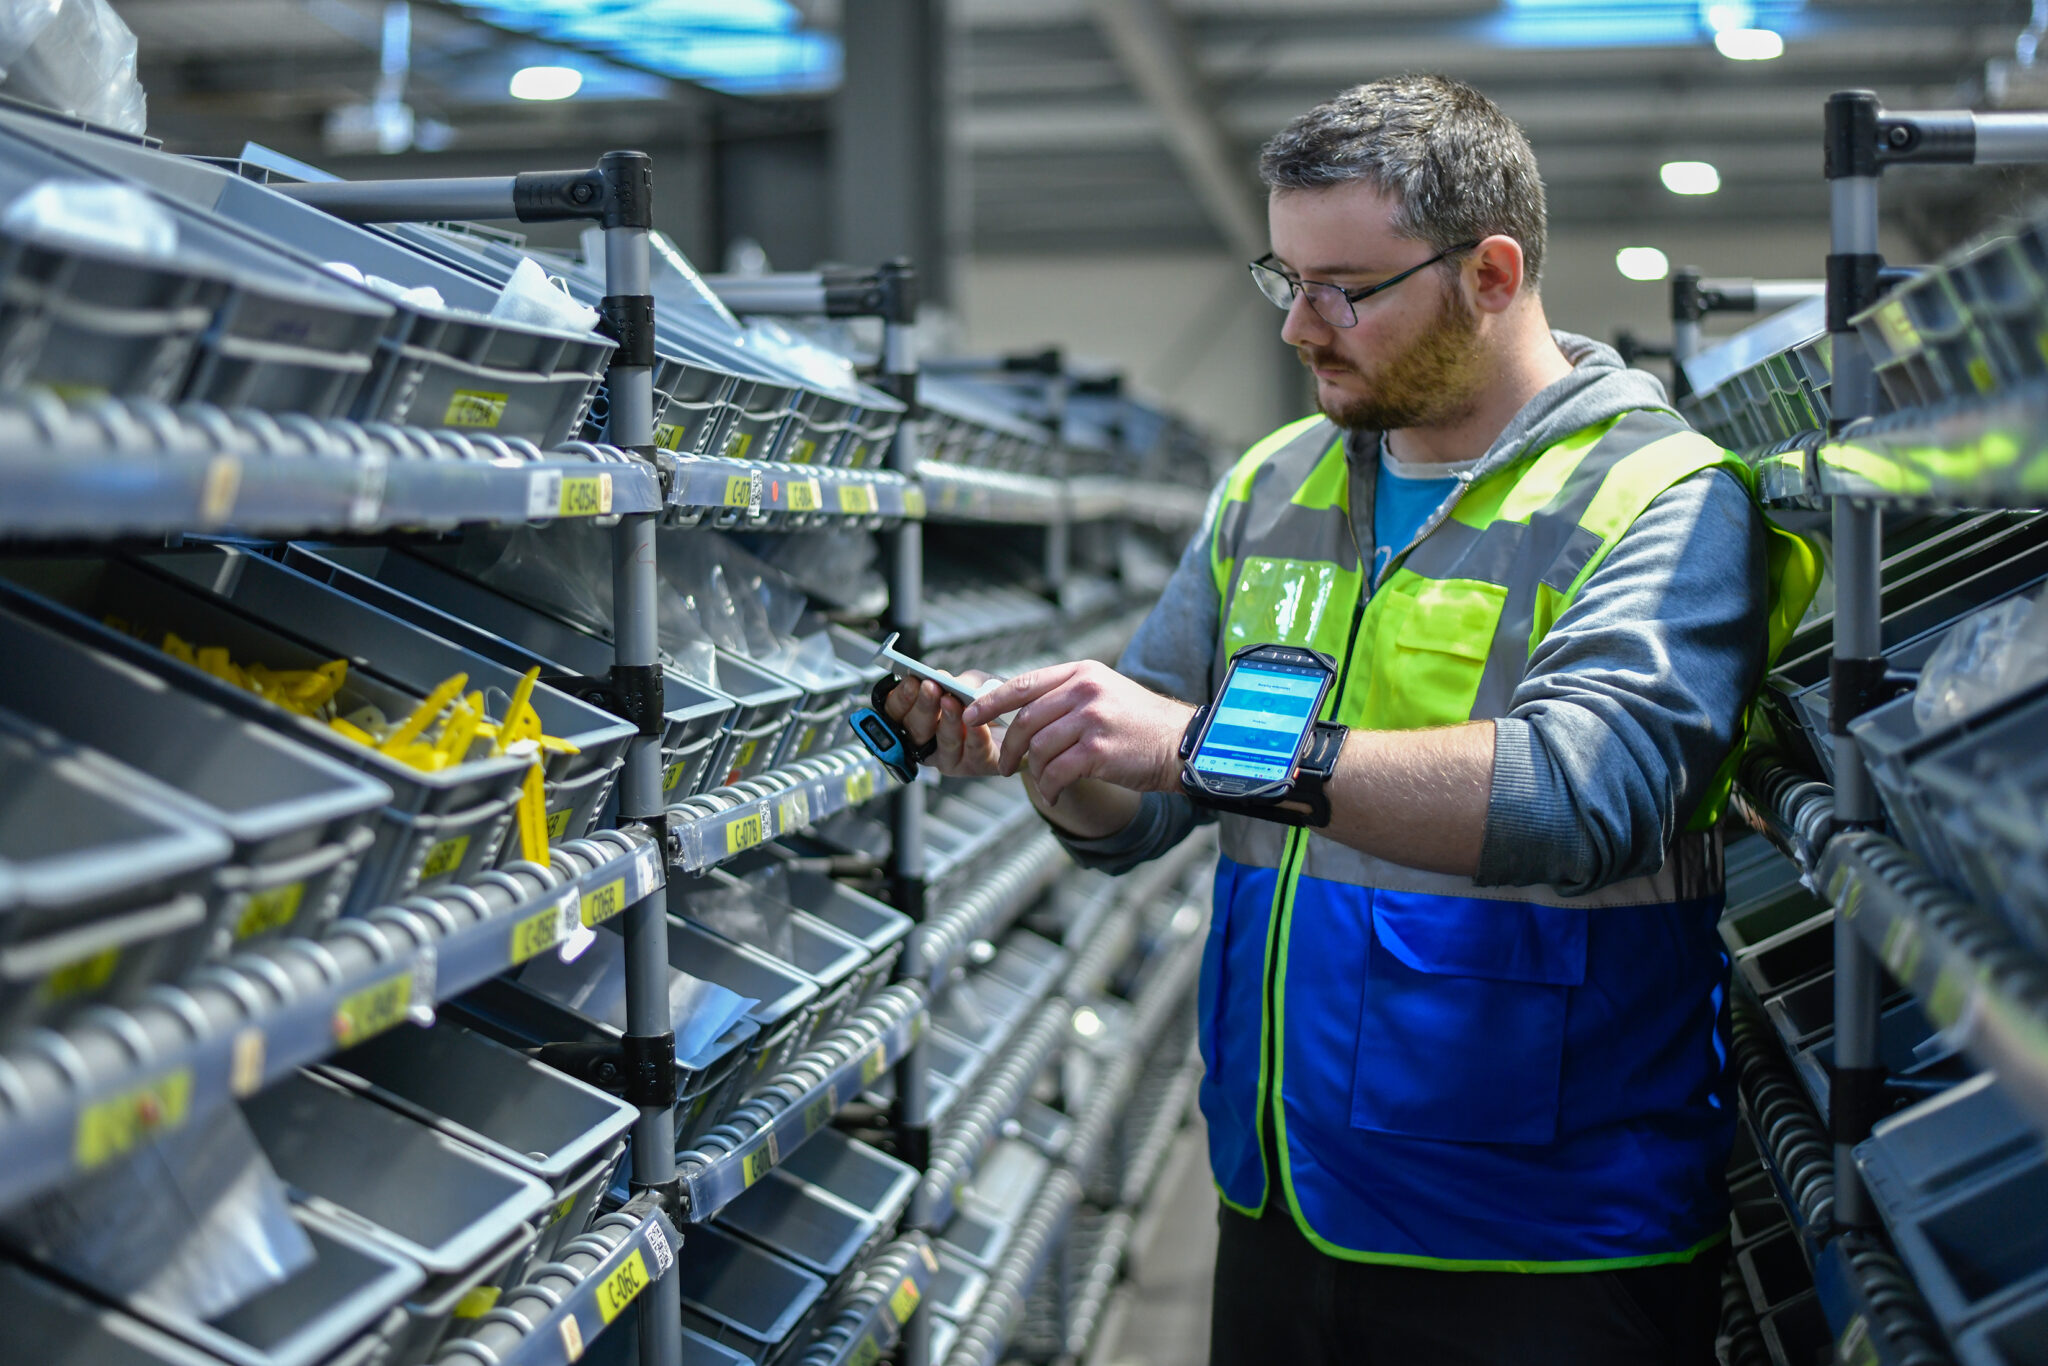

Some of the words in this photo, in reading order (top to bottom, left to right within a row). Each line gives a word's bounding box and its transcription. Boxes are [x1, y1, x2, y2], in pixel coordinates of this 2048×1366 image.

[568, 483, 598, 511] C-05A
[732, 480, 751, 504] C-07
[736, 819, 757, 848] C-07B
[608, 1261, 640, 1309] C-06C
